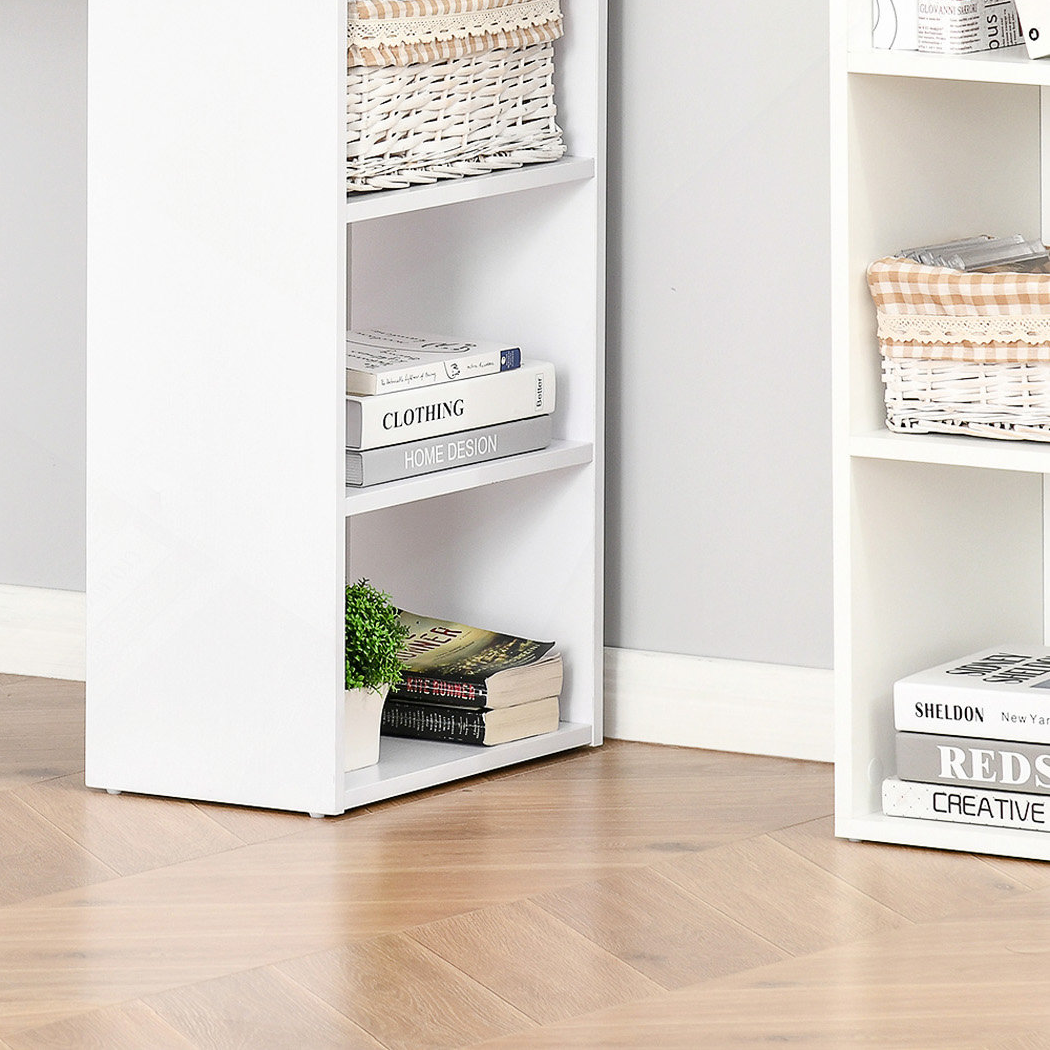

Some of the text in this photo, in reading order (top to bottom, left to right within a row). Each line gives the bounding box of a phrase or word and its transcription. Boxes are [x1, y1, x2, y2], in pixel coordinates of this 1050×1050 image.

[383, 399, 465, 430] CLOTHING
[405, 444, 444, 469] HOME
[407, 677, 476, 700] KITE RUNNER
[915, 702, 984, 723] SHELDON
[1001, 711, 1027, 723] New
[932, 792, 1046, 824] CREATIVE
